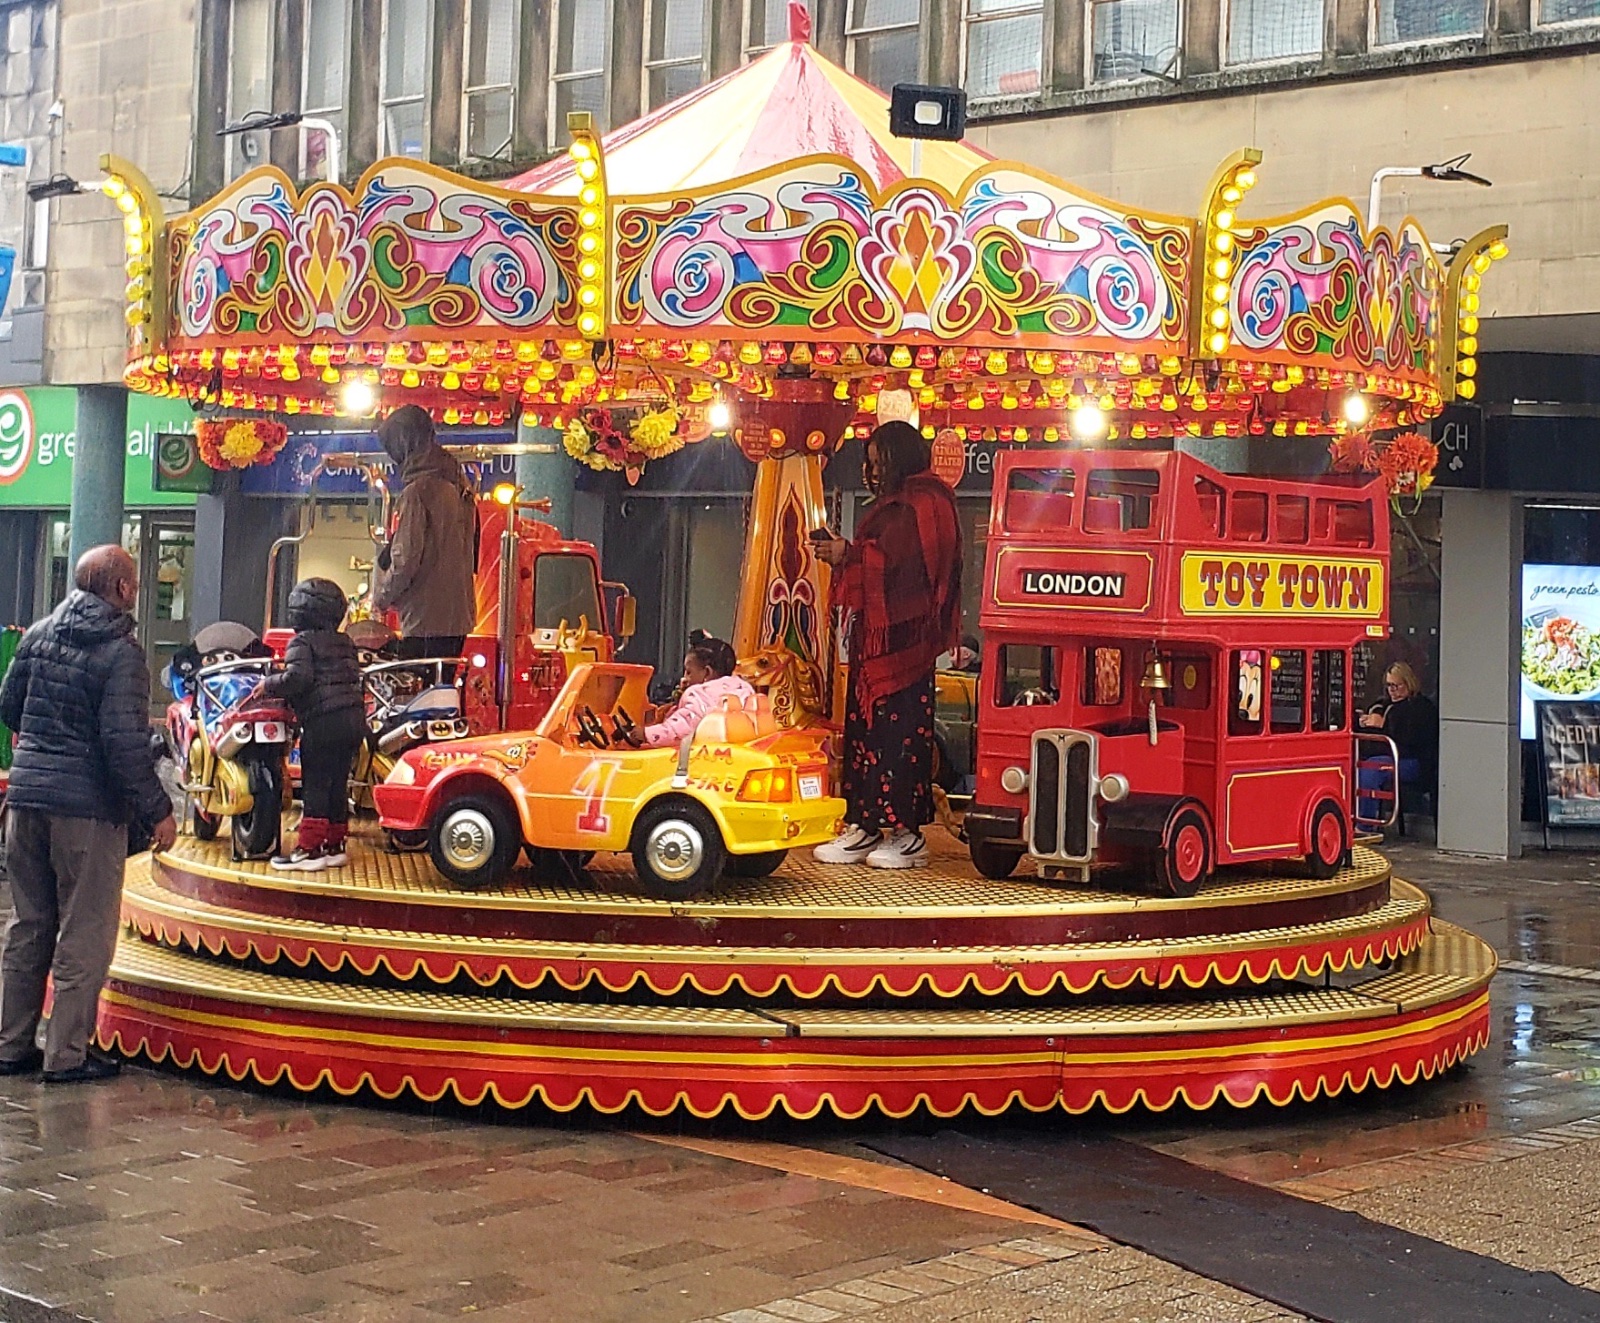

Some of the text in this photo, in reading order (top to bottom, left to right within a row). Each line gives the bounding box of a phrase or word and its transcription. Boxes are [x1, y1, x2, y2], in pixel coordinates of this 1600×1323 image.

[1025, 573, 1122, 596] LONDON
[1200, 560, 1372, 610] TOY TOWN
[1529, 581, 1599, 601] green pesto
[1548, 724, 1586, 744] ICED
